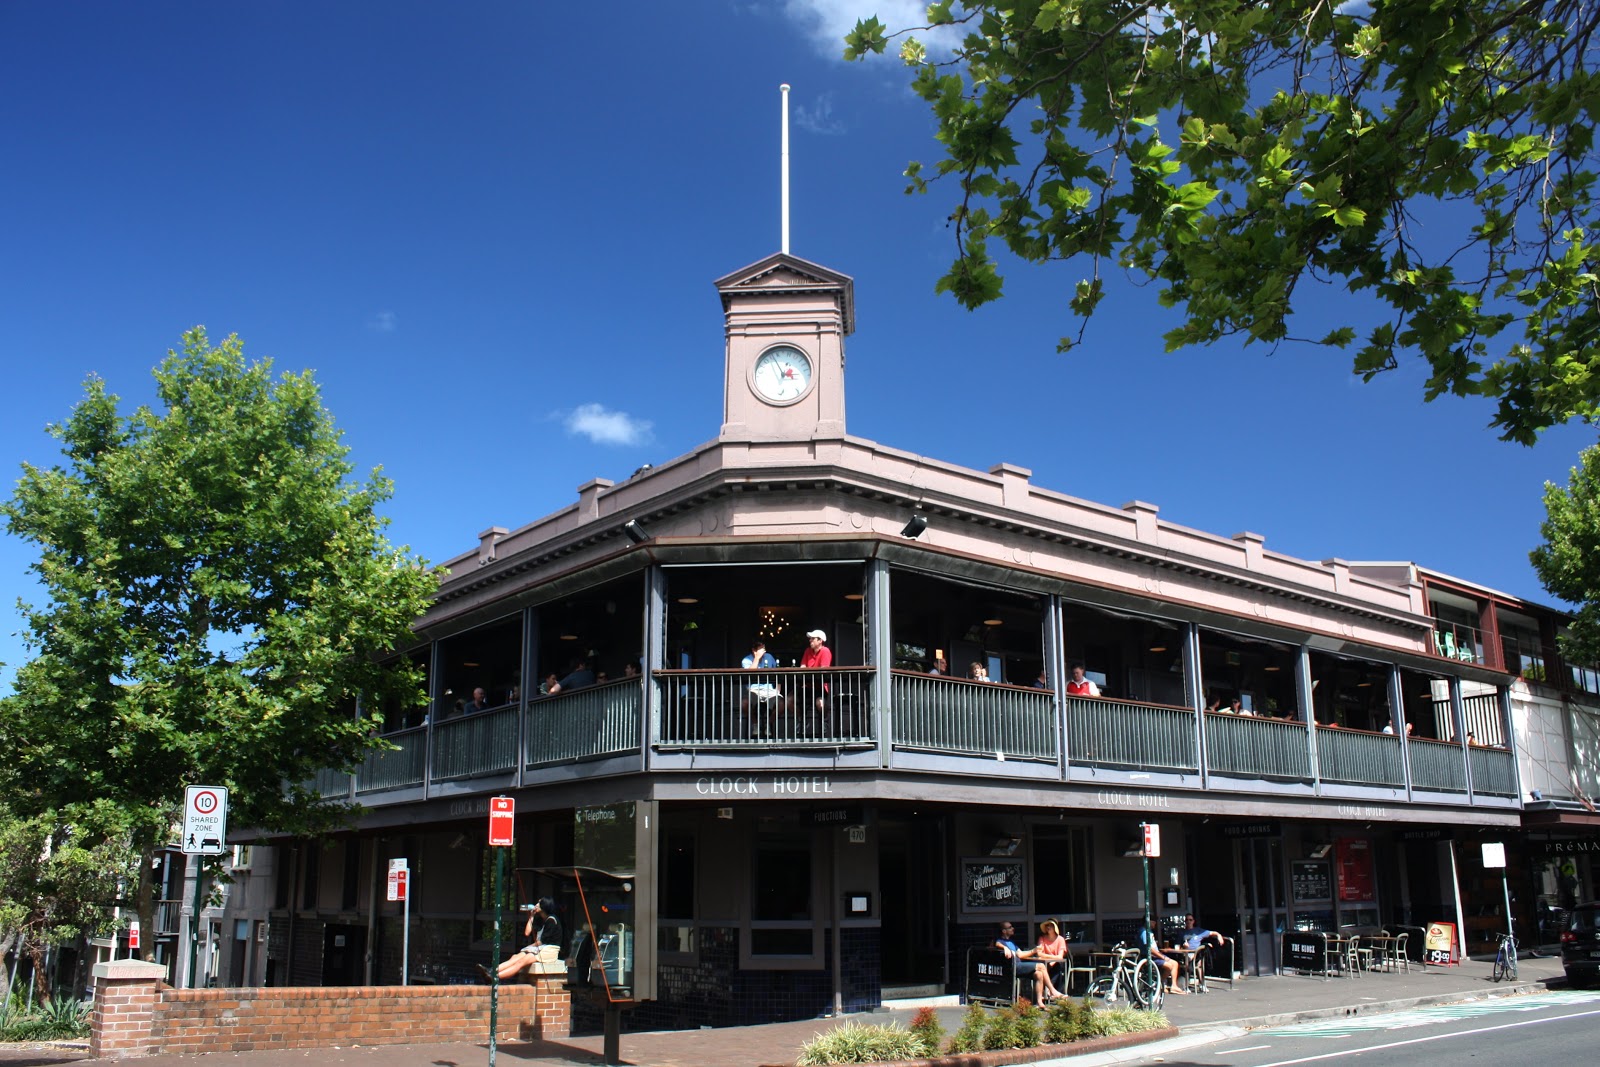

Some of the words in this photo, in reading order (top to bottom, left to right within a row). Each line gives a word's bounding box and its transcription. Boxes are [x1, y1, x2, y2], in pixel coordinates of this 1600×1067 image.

[695, 777, 758, 795] CLOCK
[773, 776, 833, 794] HOTEL
[201, 797, 212, 808] 10
[1098, 789, 1132, 805] CLOCK
[1138, 792, 1169, 808] HOTEL
[450, 800, 472, 816] CLOCK
[1338, 804, 1361, 816] CLOCK
[190, 816, 219, 824] SHARED
[584, 809, 616, 823] Telephone
[814, 810, 847, 822] FUNCTIONS
[194, 824, 213, 832] ZONE
[1247, 825, 1271, 834] DRINKS
[850, 830, 864, 841] 470
[995, 885, 1012, 900] OPEN
